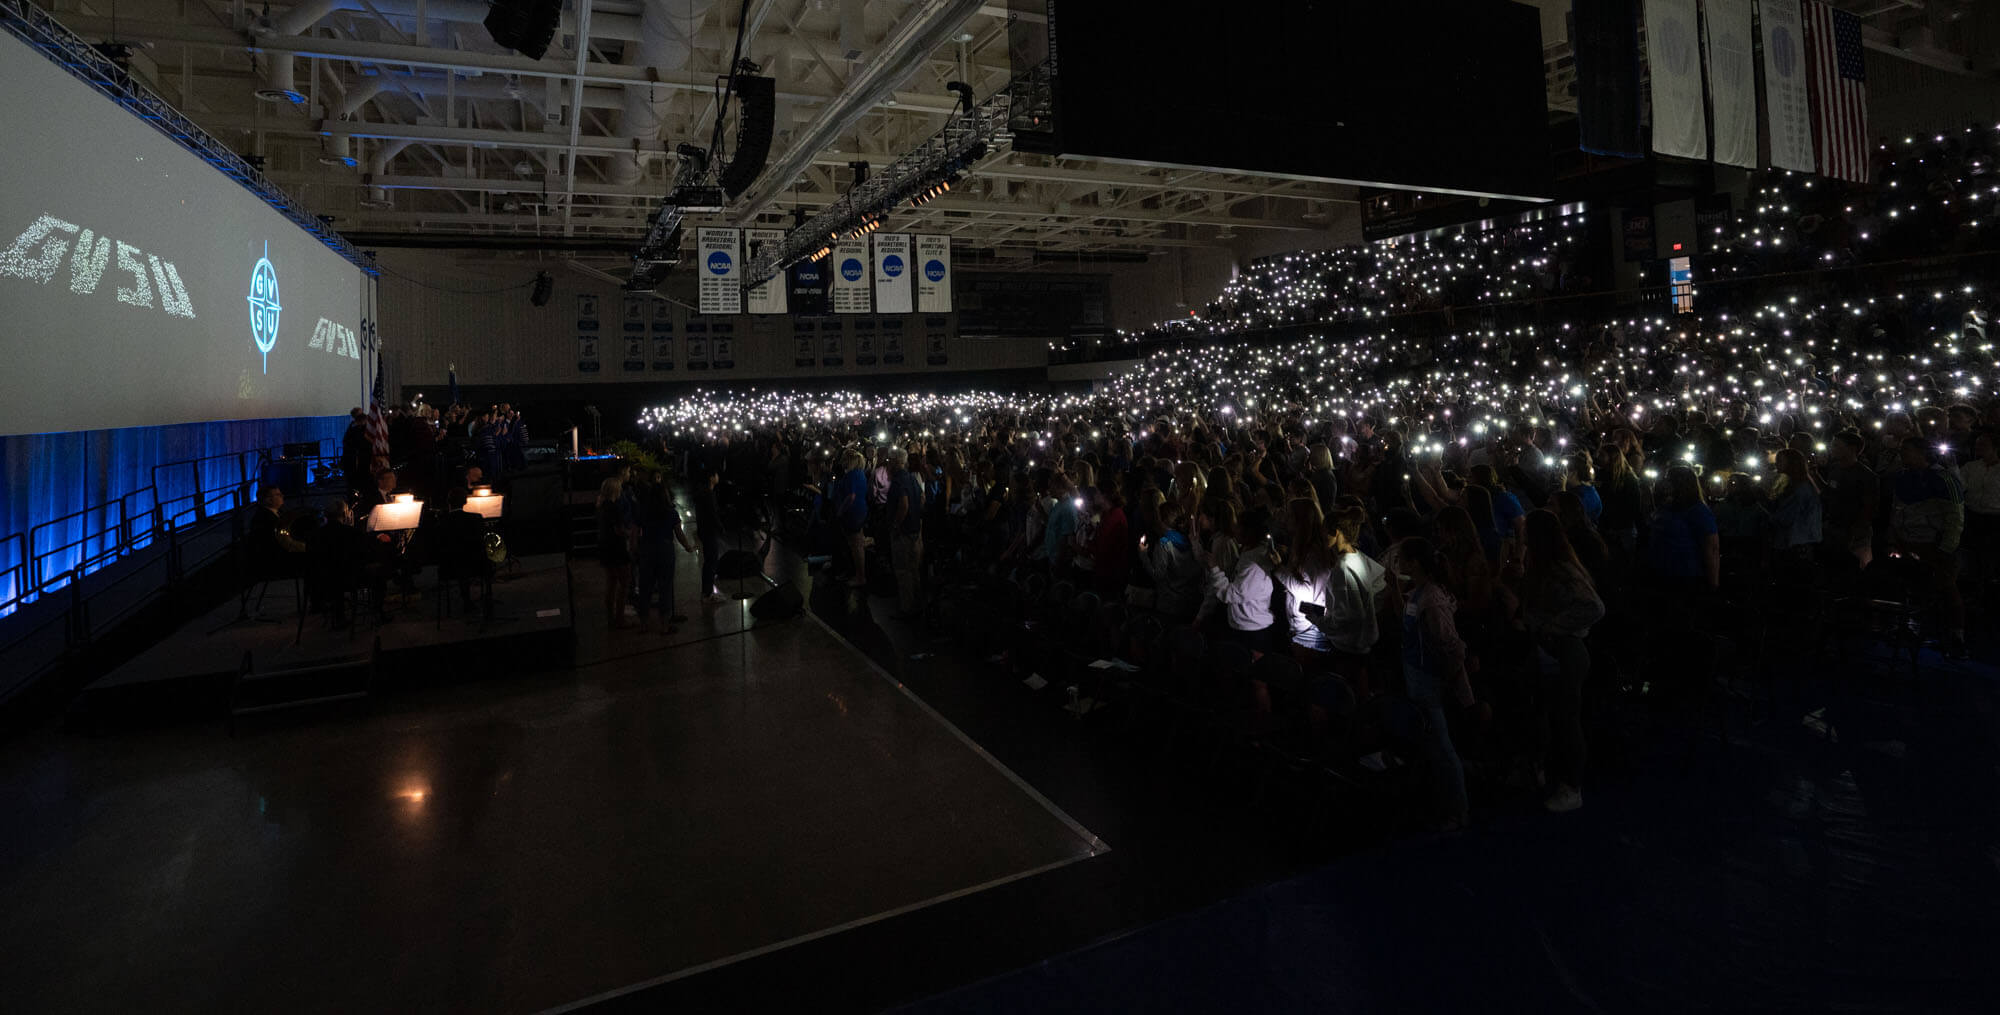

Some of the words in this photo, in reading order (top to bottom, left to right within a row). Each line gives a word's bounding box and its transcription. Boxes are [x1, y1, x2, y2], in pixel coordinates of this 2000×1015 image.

[0, 211, 196, 319] GVSU
[709, 262, 731, 270] NCAA
[885, 264, 904, 272] NCAA
[308, 316, 360, 360] GVSU
